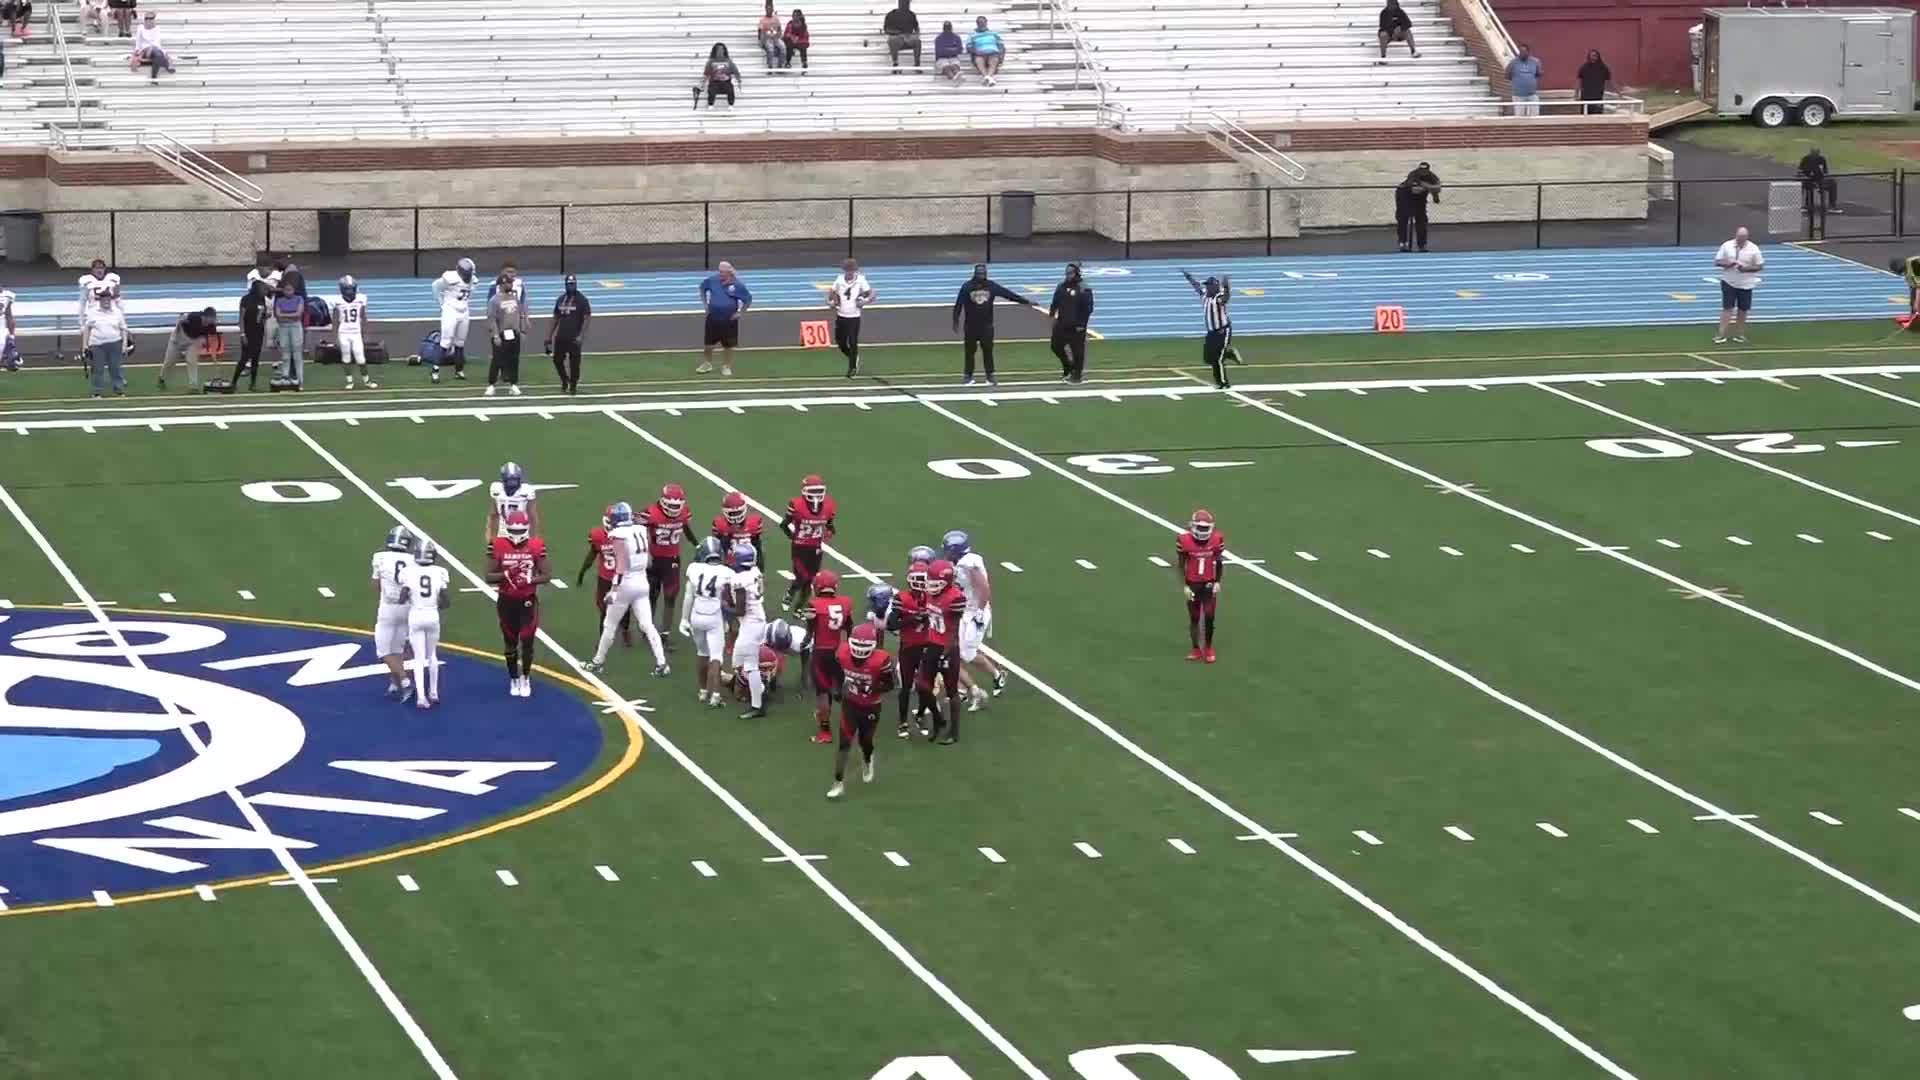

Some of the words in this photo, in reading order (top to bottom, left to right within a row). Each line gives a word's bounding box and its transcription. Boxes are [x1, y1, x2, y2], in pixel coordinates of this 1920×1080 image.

[844, 287, 852, 301] 4
[343, 308, 357, 323] 19
[1380, 309, 1400, 330] 20
[806, 325, 827, 345] 30
[633, 532, 648, 555] 11
[1196, 557, 1205, 575] 1
[419, 575, 432, 598] 9
[695, 573, 719, 598] 14
[828, 605, 843, 630] 5
